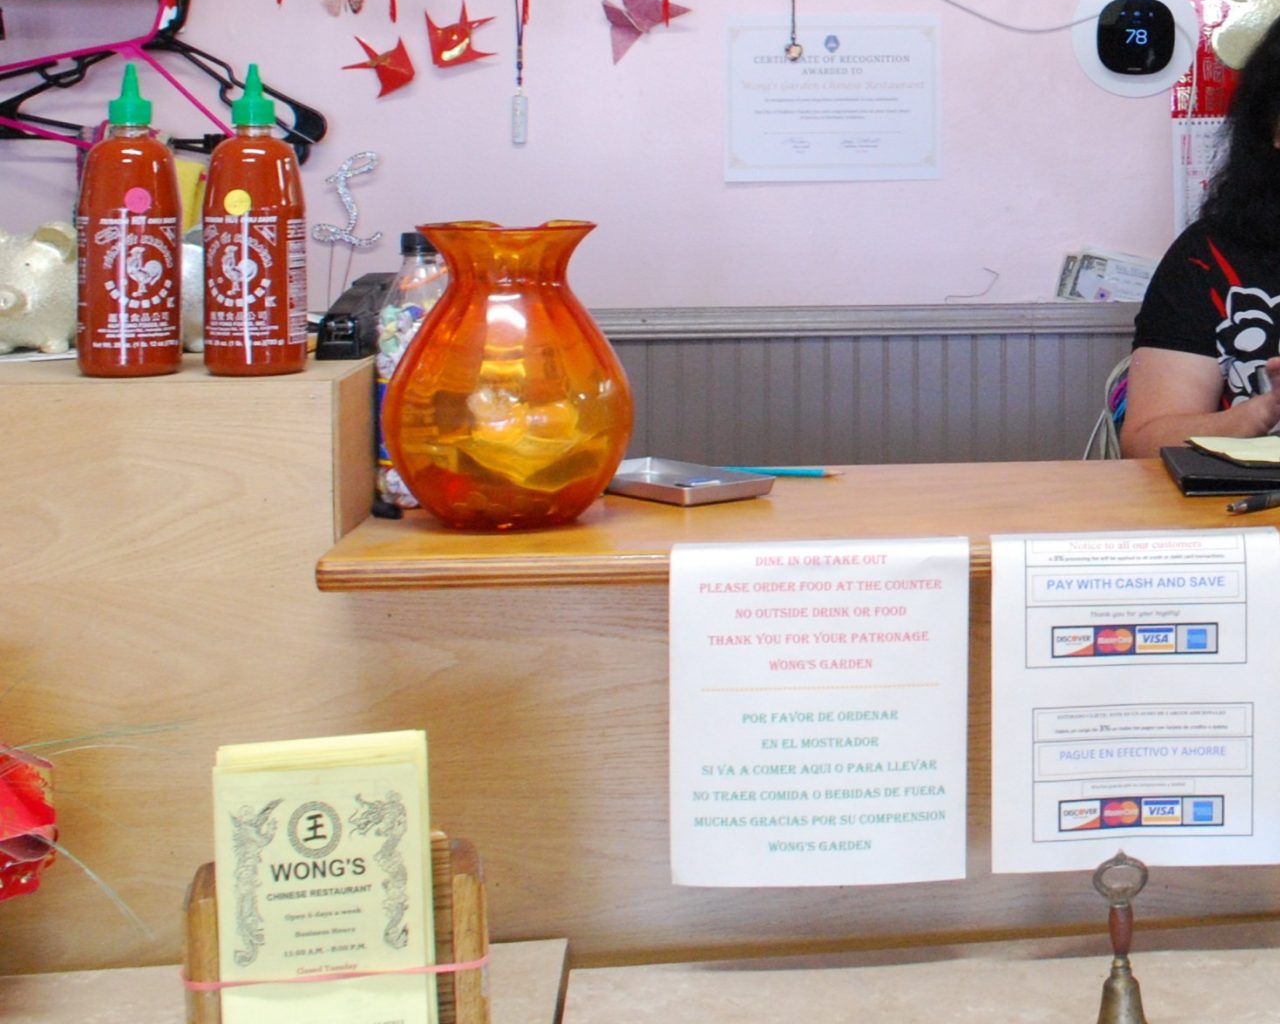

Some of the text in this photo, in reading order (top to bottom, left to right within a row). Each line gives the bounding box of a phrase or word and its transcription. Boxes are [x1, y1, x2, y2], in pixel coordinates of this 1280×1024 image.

[1125, 29, 1148, 45] 78
[754, 55, 910, 65] CERTIFATE OF RECOGNITION
[801, 67, 864, 76] AWARDED TO
[1117, 540, 1130, 550] all
[1152, 539, 1203, 549] customers
[755, 554, 888, 567] DINE IN OR TAKE OUT
[699, 579, 943, 593] PLEASE ORDER FOOD AT THE COUNTER
[1046, 576, 1225, 590] PAY WITH CASH AND SAVE
[735, 606, 907, 619] NO OUTSIDE DRINK OR FOOD
[708, 631, 930, 646] THANK YOU FOR YOUR PATRONAGE
[1056, 634, 1091, 644] DISCOVER
[1142, 634, 1169, 644] VISA
[769, 659, 873, 671] WONG'S GARDEN
[742, 710, 898, 724] POR FAVOR DE ORDENAR
[761, 737, 879, 749] EN EL MOSTRADOR
[1059, 746, 1227, 760] PAGUE EN EFECTIVO Y AHORRE
[702, 760, 937, 776] SI VA A COMER AQUI O PARA LLEVAR
[692, 785, 946, 801] NO TRAER COMIDA O BEBIDAS DE FUERA
[1063, 808, 1097, 817] DISCOVER
[1148, 807, 1175, 816] VISA
[694, 810, 946, 827] MUCHAS GRACIAS POR SU COMPRENSION
[303, 813, 327, 843] 王
[768, 840, 872, 852] WONG'S GARDEN
[270, 857, 366, 882] WONG'S
[266, 884, 372, 901] CHINESE RESTAURANT
[294, 927, 356, 938] Business Hours
